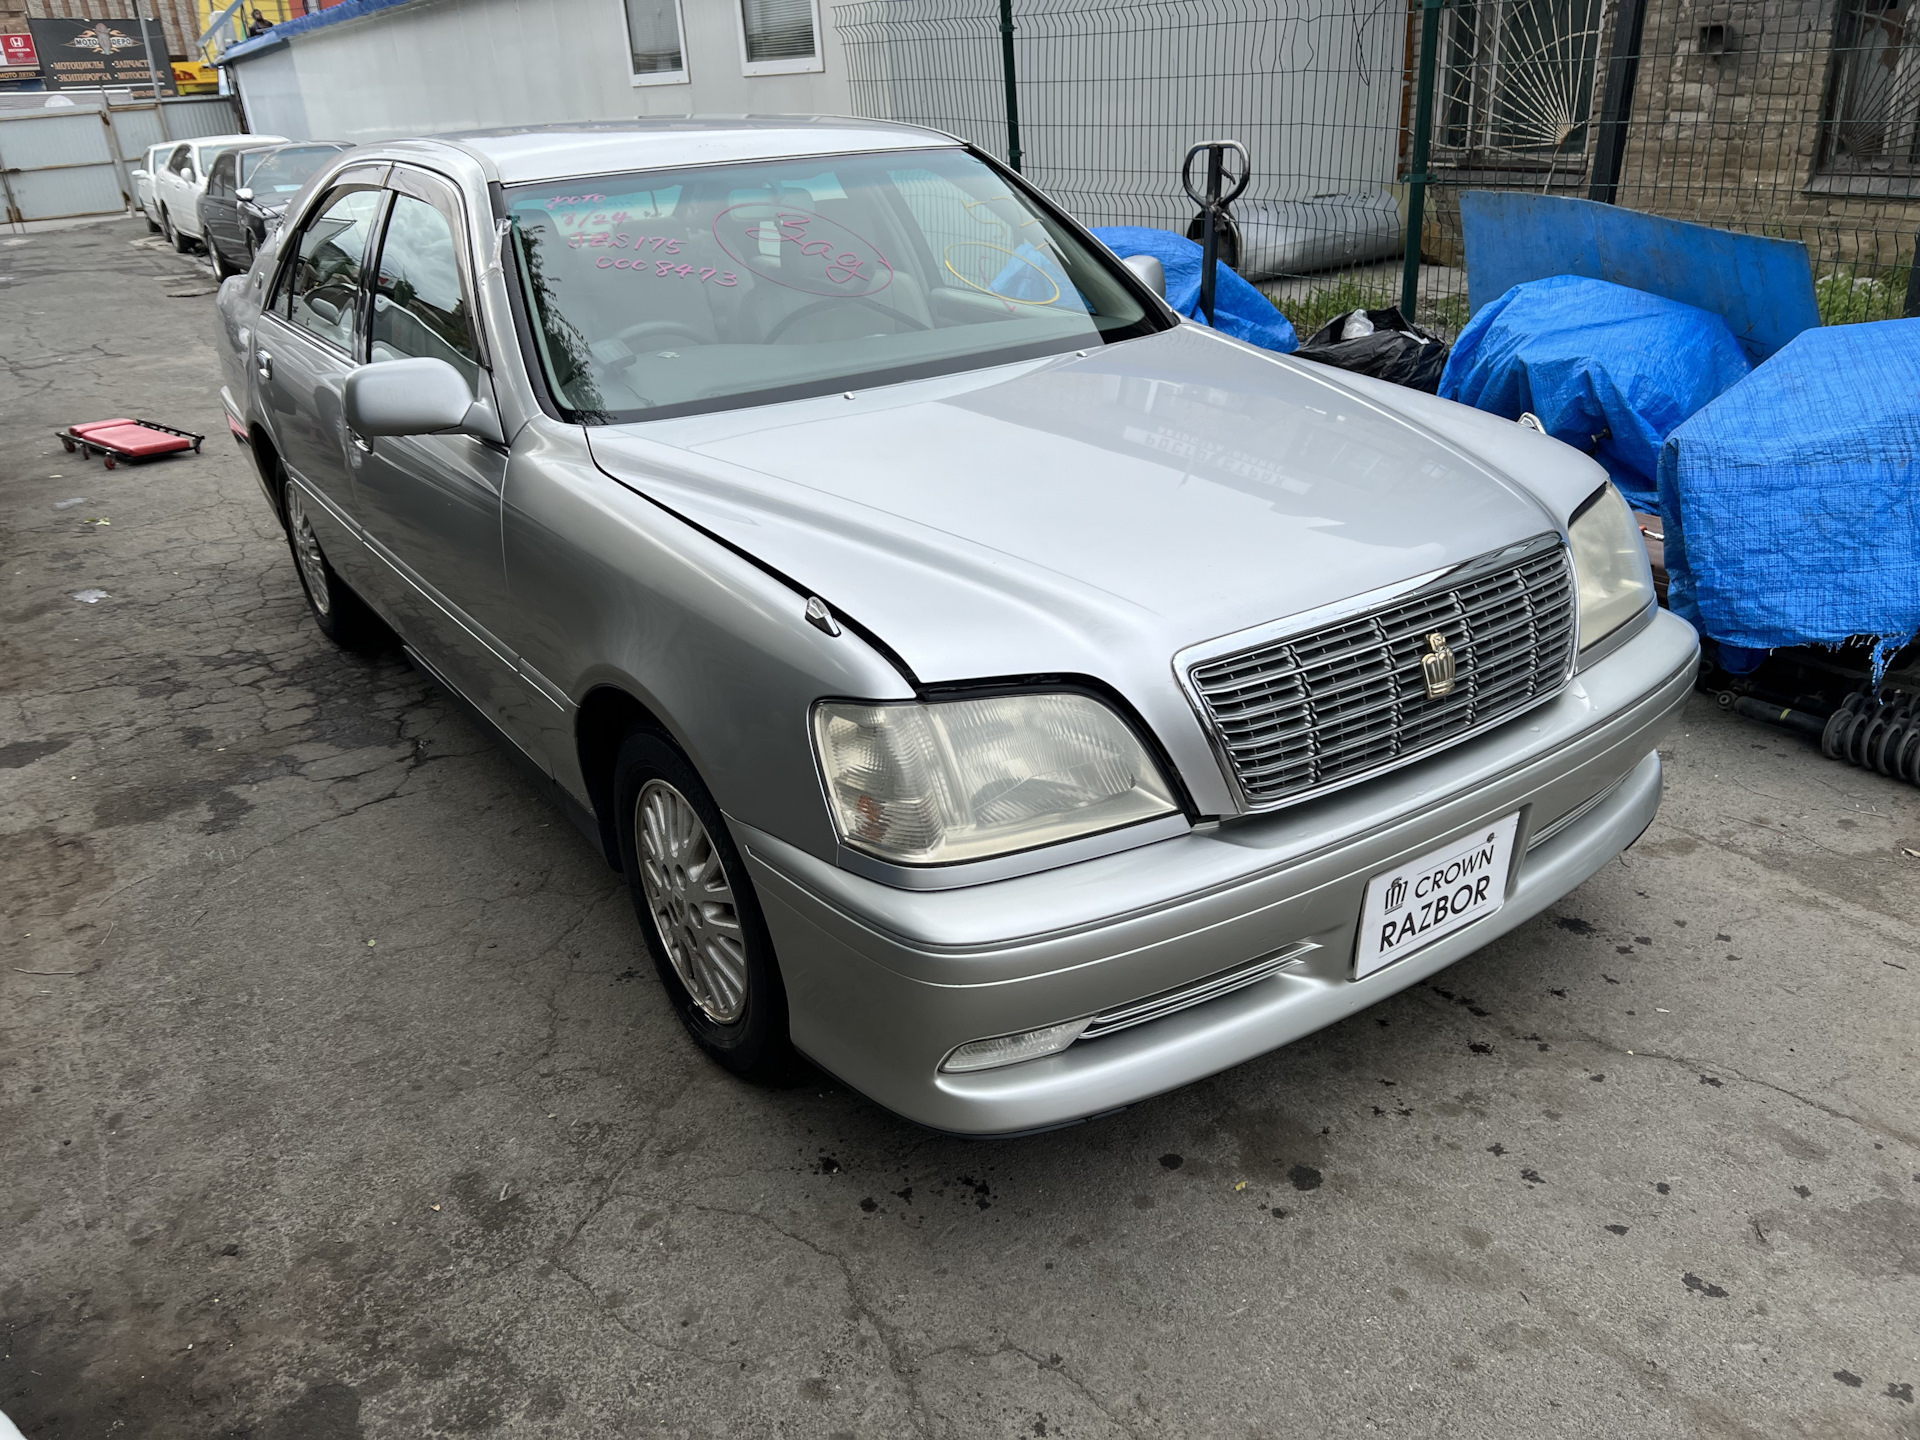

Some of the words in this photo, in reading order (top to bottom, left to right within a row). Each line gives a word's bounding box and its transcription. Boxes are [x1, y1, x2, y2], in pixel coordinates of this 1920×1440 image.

[54, 61, 105, 70] МОТОЦИКЛЫ
[114, 59, 150, 68] ЗАПЧАСТ
[1415, 845, 1494, 898] CROWN
[1379, 875, 1490, 953] RAZBOR
